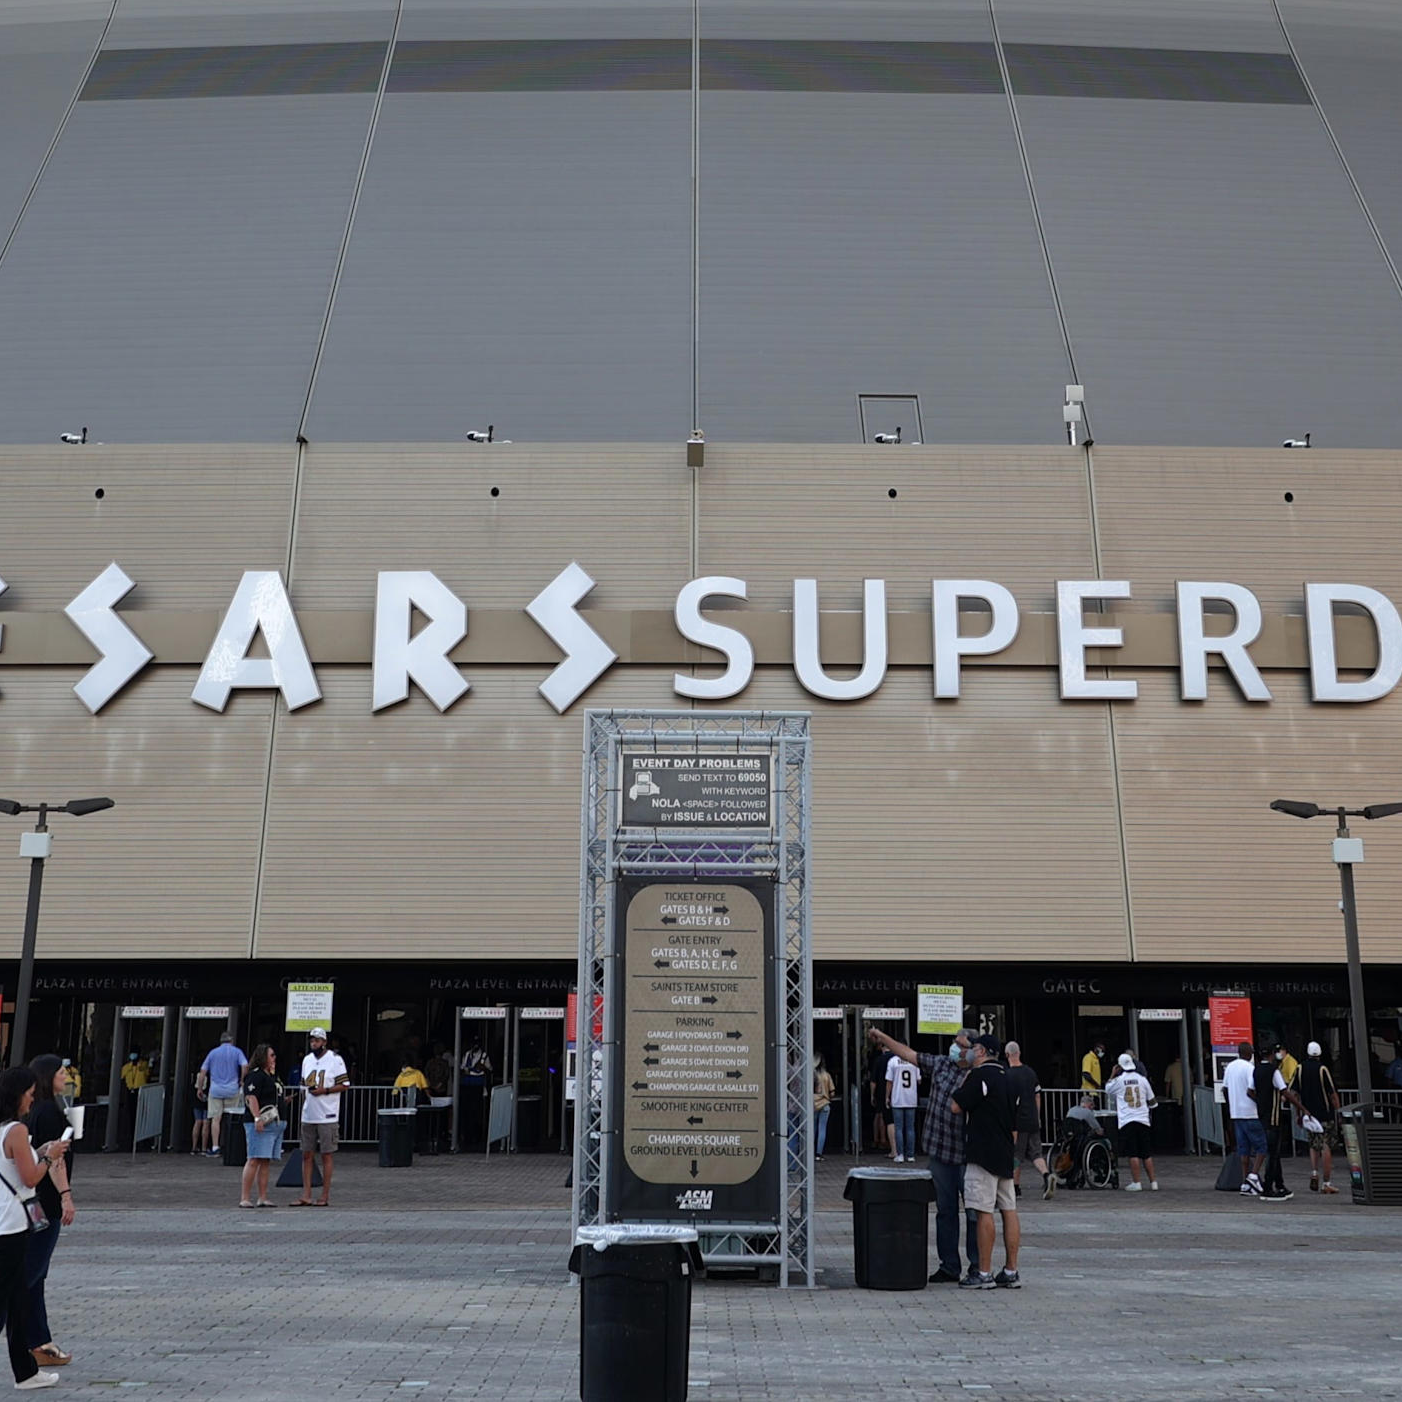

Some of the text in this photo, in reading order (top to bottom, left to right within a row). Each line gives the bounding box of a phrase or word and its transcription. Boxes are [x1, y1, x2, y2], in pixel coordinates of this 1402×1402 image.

[632, 758, 761, 768] EVENT DAY PROBLEMS
[677, 772, 767, 782] SEND TEXT TO 69050
[701, 787, 767, 796] WITH KEYWORD
[651, 798, 680, 808] NOLA
[720, 800, 767, 809] FOLLOWED
[661, 811, 767, 821] BY ISSUE & LOCATION
[665, 892, 726, 902] TICKET OFFICE
[660, 904, 713, 914] GATES B & H
[678, 916, 731, 926] GATES F & D
[668, 935, 723, 945] GATE ENTRY
[651, 948, 680, 958] GATES
[712, 949, 720, 958] G
[671, 960, 701, 970] GATES
[730, 961, 738, 970] G
[35, 978, 190, 990] PLAZA LEVEL ENTRANCE
[429, 979, 576, 990] PLAZA LEVEL ENTRAN
[651, 982, 739, 992] SAINTS TEAM STORE
[813, 980, 848, 991] LAZA
[852, 980, 890, 991] LEVEL
[1042, 978, 1102, 994] GATE C
[1269, 982, 1335, 993] ENTRANCE
[671, 996, 693, 1005] GATE
[676, 1017, 715, 1027] PARKING
[647, 1031, 675, 1039] GARAGE
[660, 1044, 689, 1053] GARAGE
[689, 1045, 694, 1053] 2
[693, 1045, 714, 1054] (DAVE
[660, 1058, 689, 1067] GARAGE
[693, 1059, 714, 1068] (DAVE
[305, 1069, 326, 1089] 41
[645, 1070, 674, 1078] GARAGE
[901, 1070, 912, 1089] 9
[648, 1084, 689, 1092] CHAMPIONS
[689, 1084, 717, 1092] GARAGE
[1123, 1086, 1142, 1108] 41
[640, 1102, 750, 1112] SMOOTHIE KING CENTER
[648, 1134, 741, 1146] CHAMPIONS SQUARE
[630, 1146, 759, 1158] GROUND LEVEL (LASALLE ST)
[681, 1190, 714, 1205] ASM
